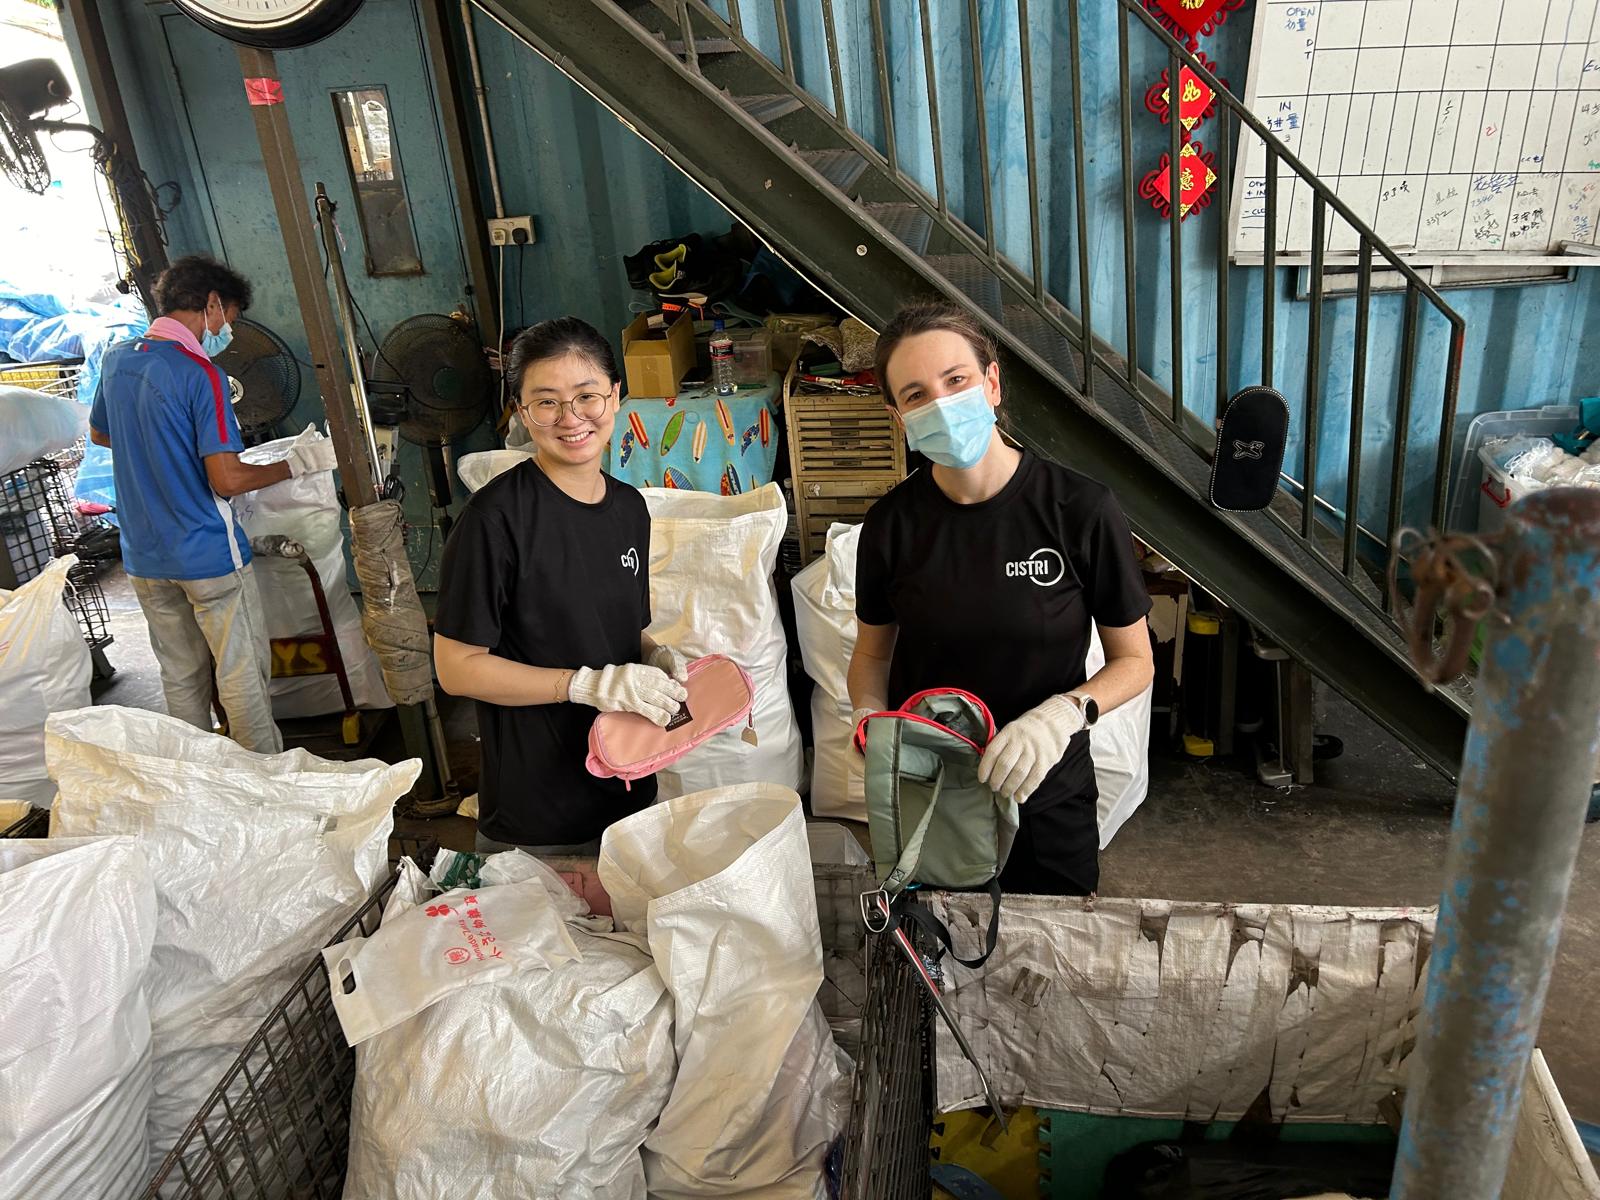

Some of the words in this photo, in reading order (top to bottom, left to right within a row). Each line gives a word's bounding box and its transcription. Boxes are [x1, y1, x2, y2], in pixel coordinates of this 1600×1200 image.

[1286, 6, 1315, 17] OPEN
[1279, 101, 1292, 112] IN
[1005, 559, 1049, 577] CISTRI
